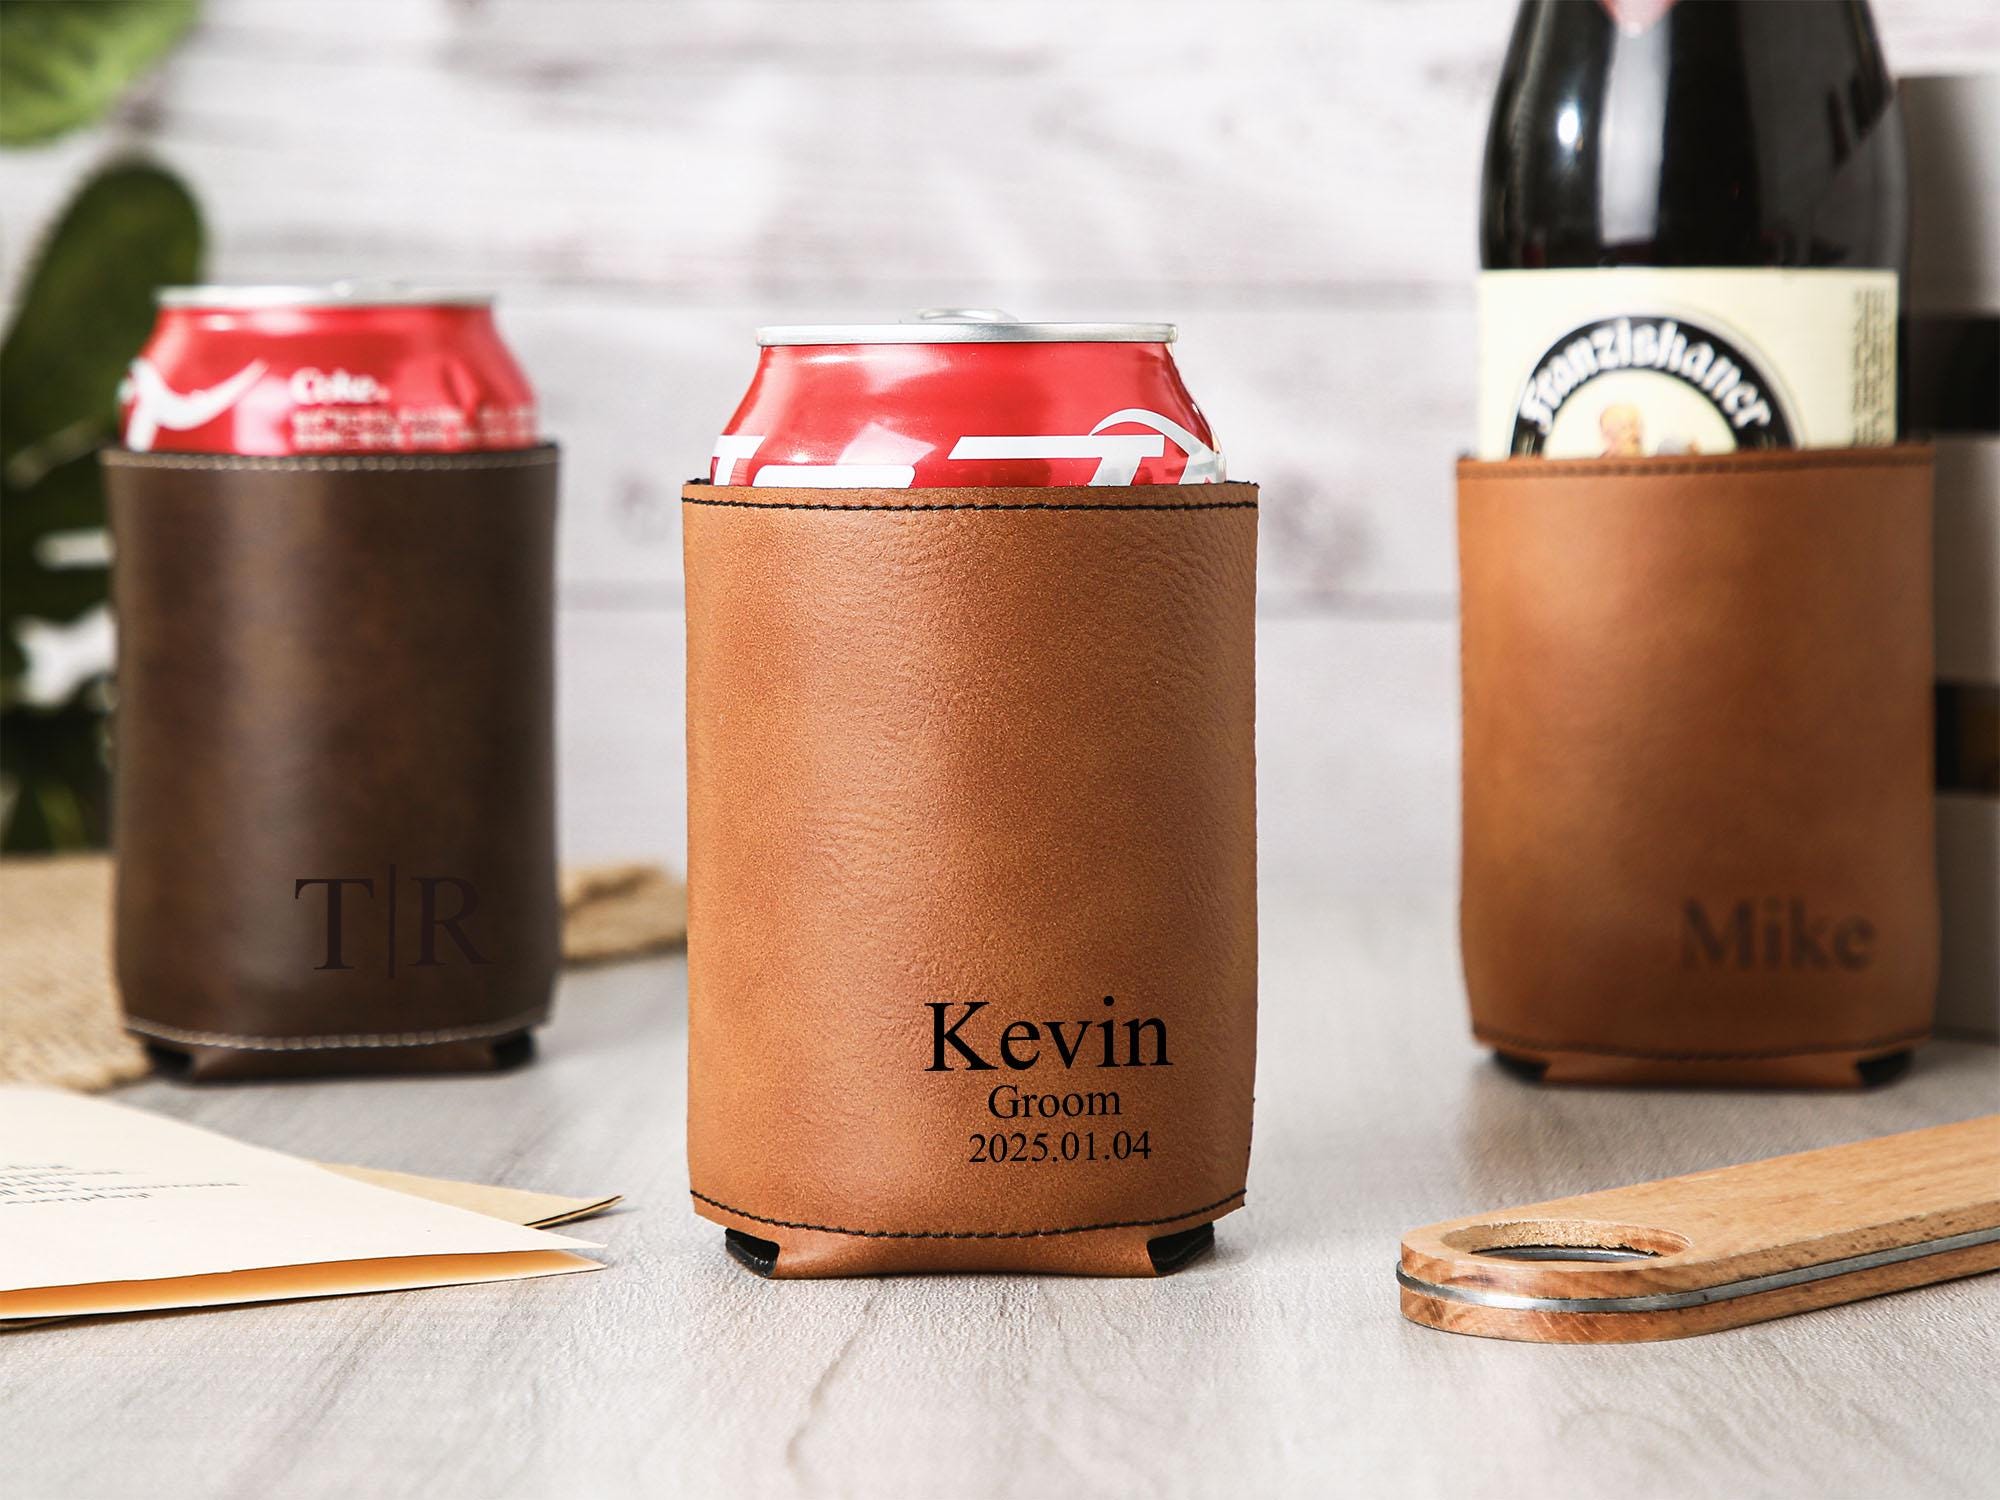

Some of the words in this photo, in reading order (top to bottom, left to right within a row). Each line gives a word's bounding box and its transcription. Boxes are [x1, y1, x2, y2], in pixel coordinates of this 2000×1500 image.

[1681, 896, 1877, 972] Mike
[924, 995, 1174, 1072] Kevin
[988, 1084, 1123, 1119] Groom
[968, 1130, 1152, 1163] 2025.01.04
